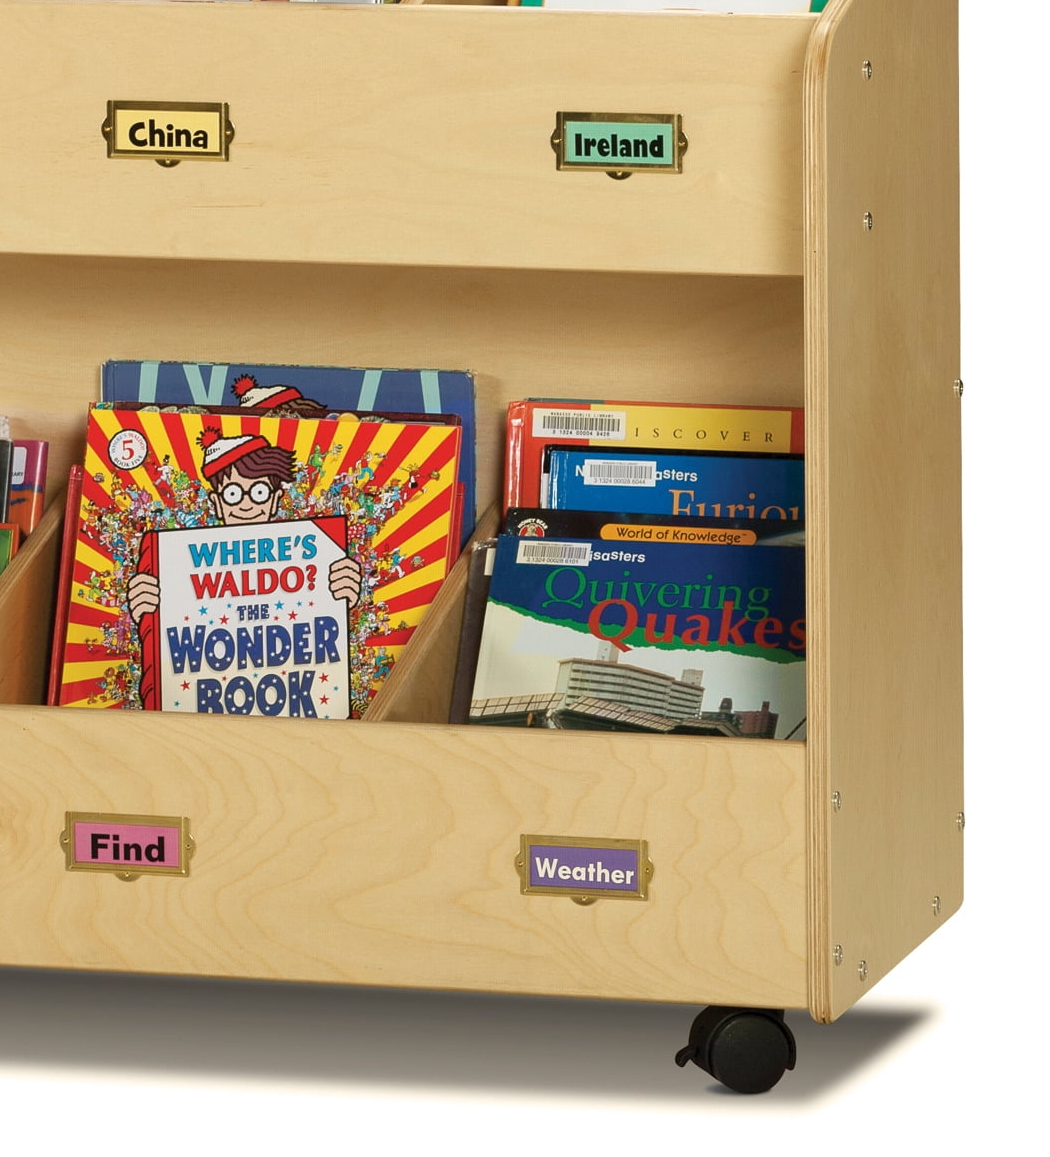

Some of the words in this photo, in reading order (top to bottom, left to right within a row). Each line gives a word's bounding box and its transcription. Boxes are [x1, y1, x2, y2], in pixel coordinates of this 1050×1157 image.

[128, 119, 208, 149] China
[574, 133, 664, 158] Ireland
[121, 439, 135, 461] 5
[634, 427, 774, 443] ISCOVER
[655, 469, 698, 482] asters
[668, 488, 799, 521] Furio
[616, 527, 653, 540] World
[655, 528, 670, 541] of
[188, 534, 318, 569] WHERE'S
[589, 550, 646, 563] isasters
[190, 564, 318, 600] WALDO?
[541, 566, 772, 622] Quivering
[236, 604, 270, 621] THE
[587, 598, 806, 653] Quakes
[166, 615, 341, 675] WONDER
[197, 671, 318, 719] BOOK
[90, 833, 165, 863] Find
[535, 856, 635, 885] Weather
